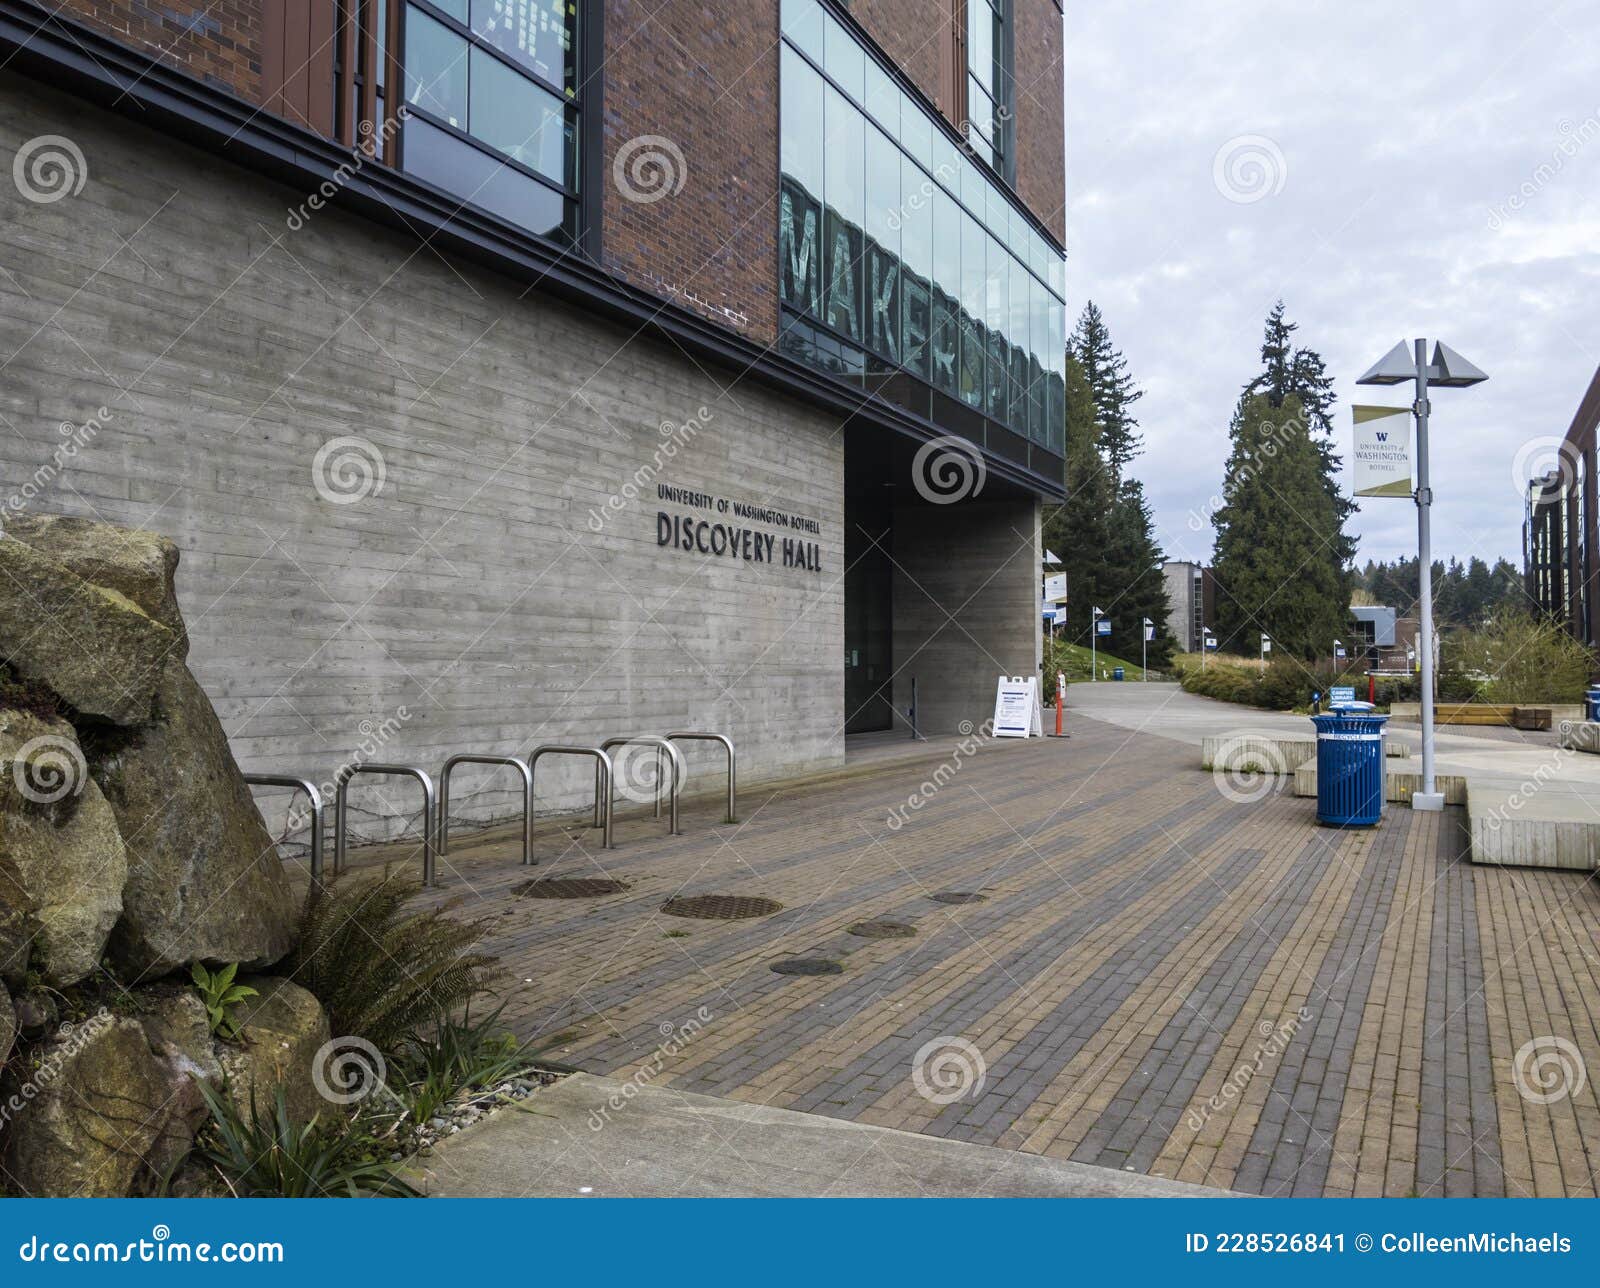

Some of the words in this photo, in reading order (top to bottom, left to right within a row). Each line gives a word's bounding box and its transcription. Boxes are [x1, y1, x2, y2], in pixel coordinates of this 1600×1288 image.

[1376, 432, 1388, 441] W
[1360, 443, 1397, 451] UNIVERSITY
[1355, 452, 1408, 461] WASHINGTON
[1369, 464, 1396, 472] BOTHELL
[658, 483, 713, 510] UNIVERSITY
[717, 499, 729, 513] OF
[733, 502, 788, 527] WASHINGTON
[791, 516, 820, 534] BOTHELL
[657, 511, 775, 564] DISCOVERY
[783, 537, 822, 572] HALL
